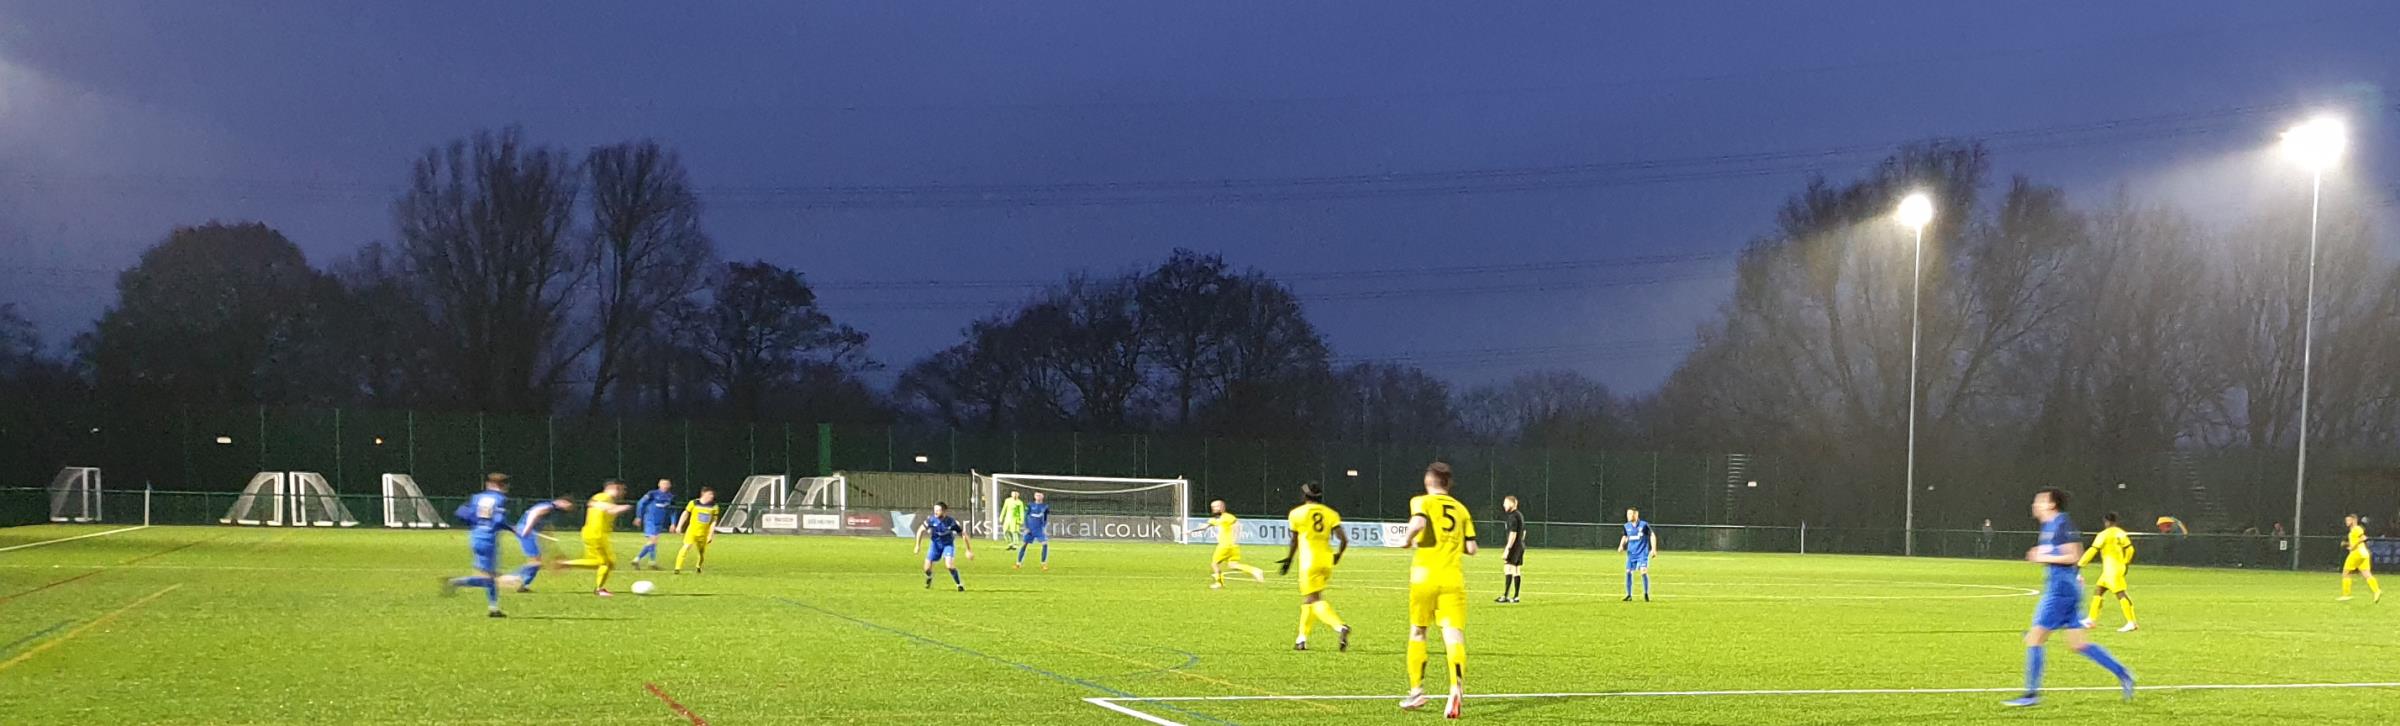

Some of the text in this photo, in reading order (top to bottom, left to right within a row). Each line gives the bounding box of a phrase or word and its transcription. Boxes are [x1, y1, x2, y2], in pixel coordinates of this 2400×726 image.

[1312, 512, 1324, 533] 8
[1442, 504, 1456, 532] 5
[1351, 527, 1379, 541] 515
